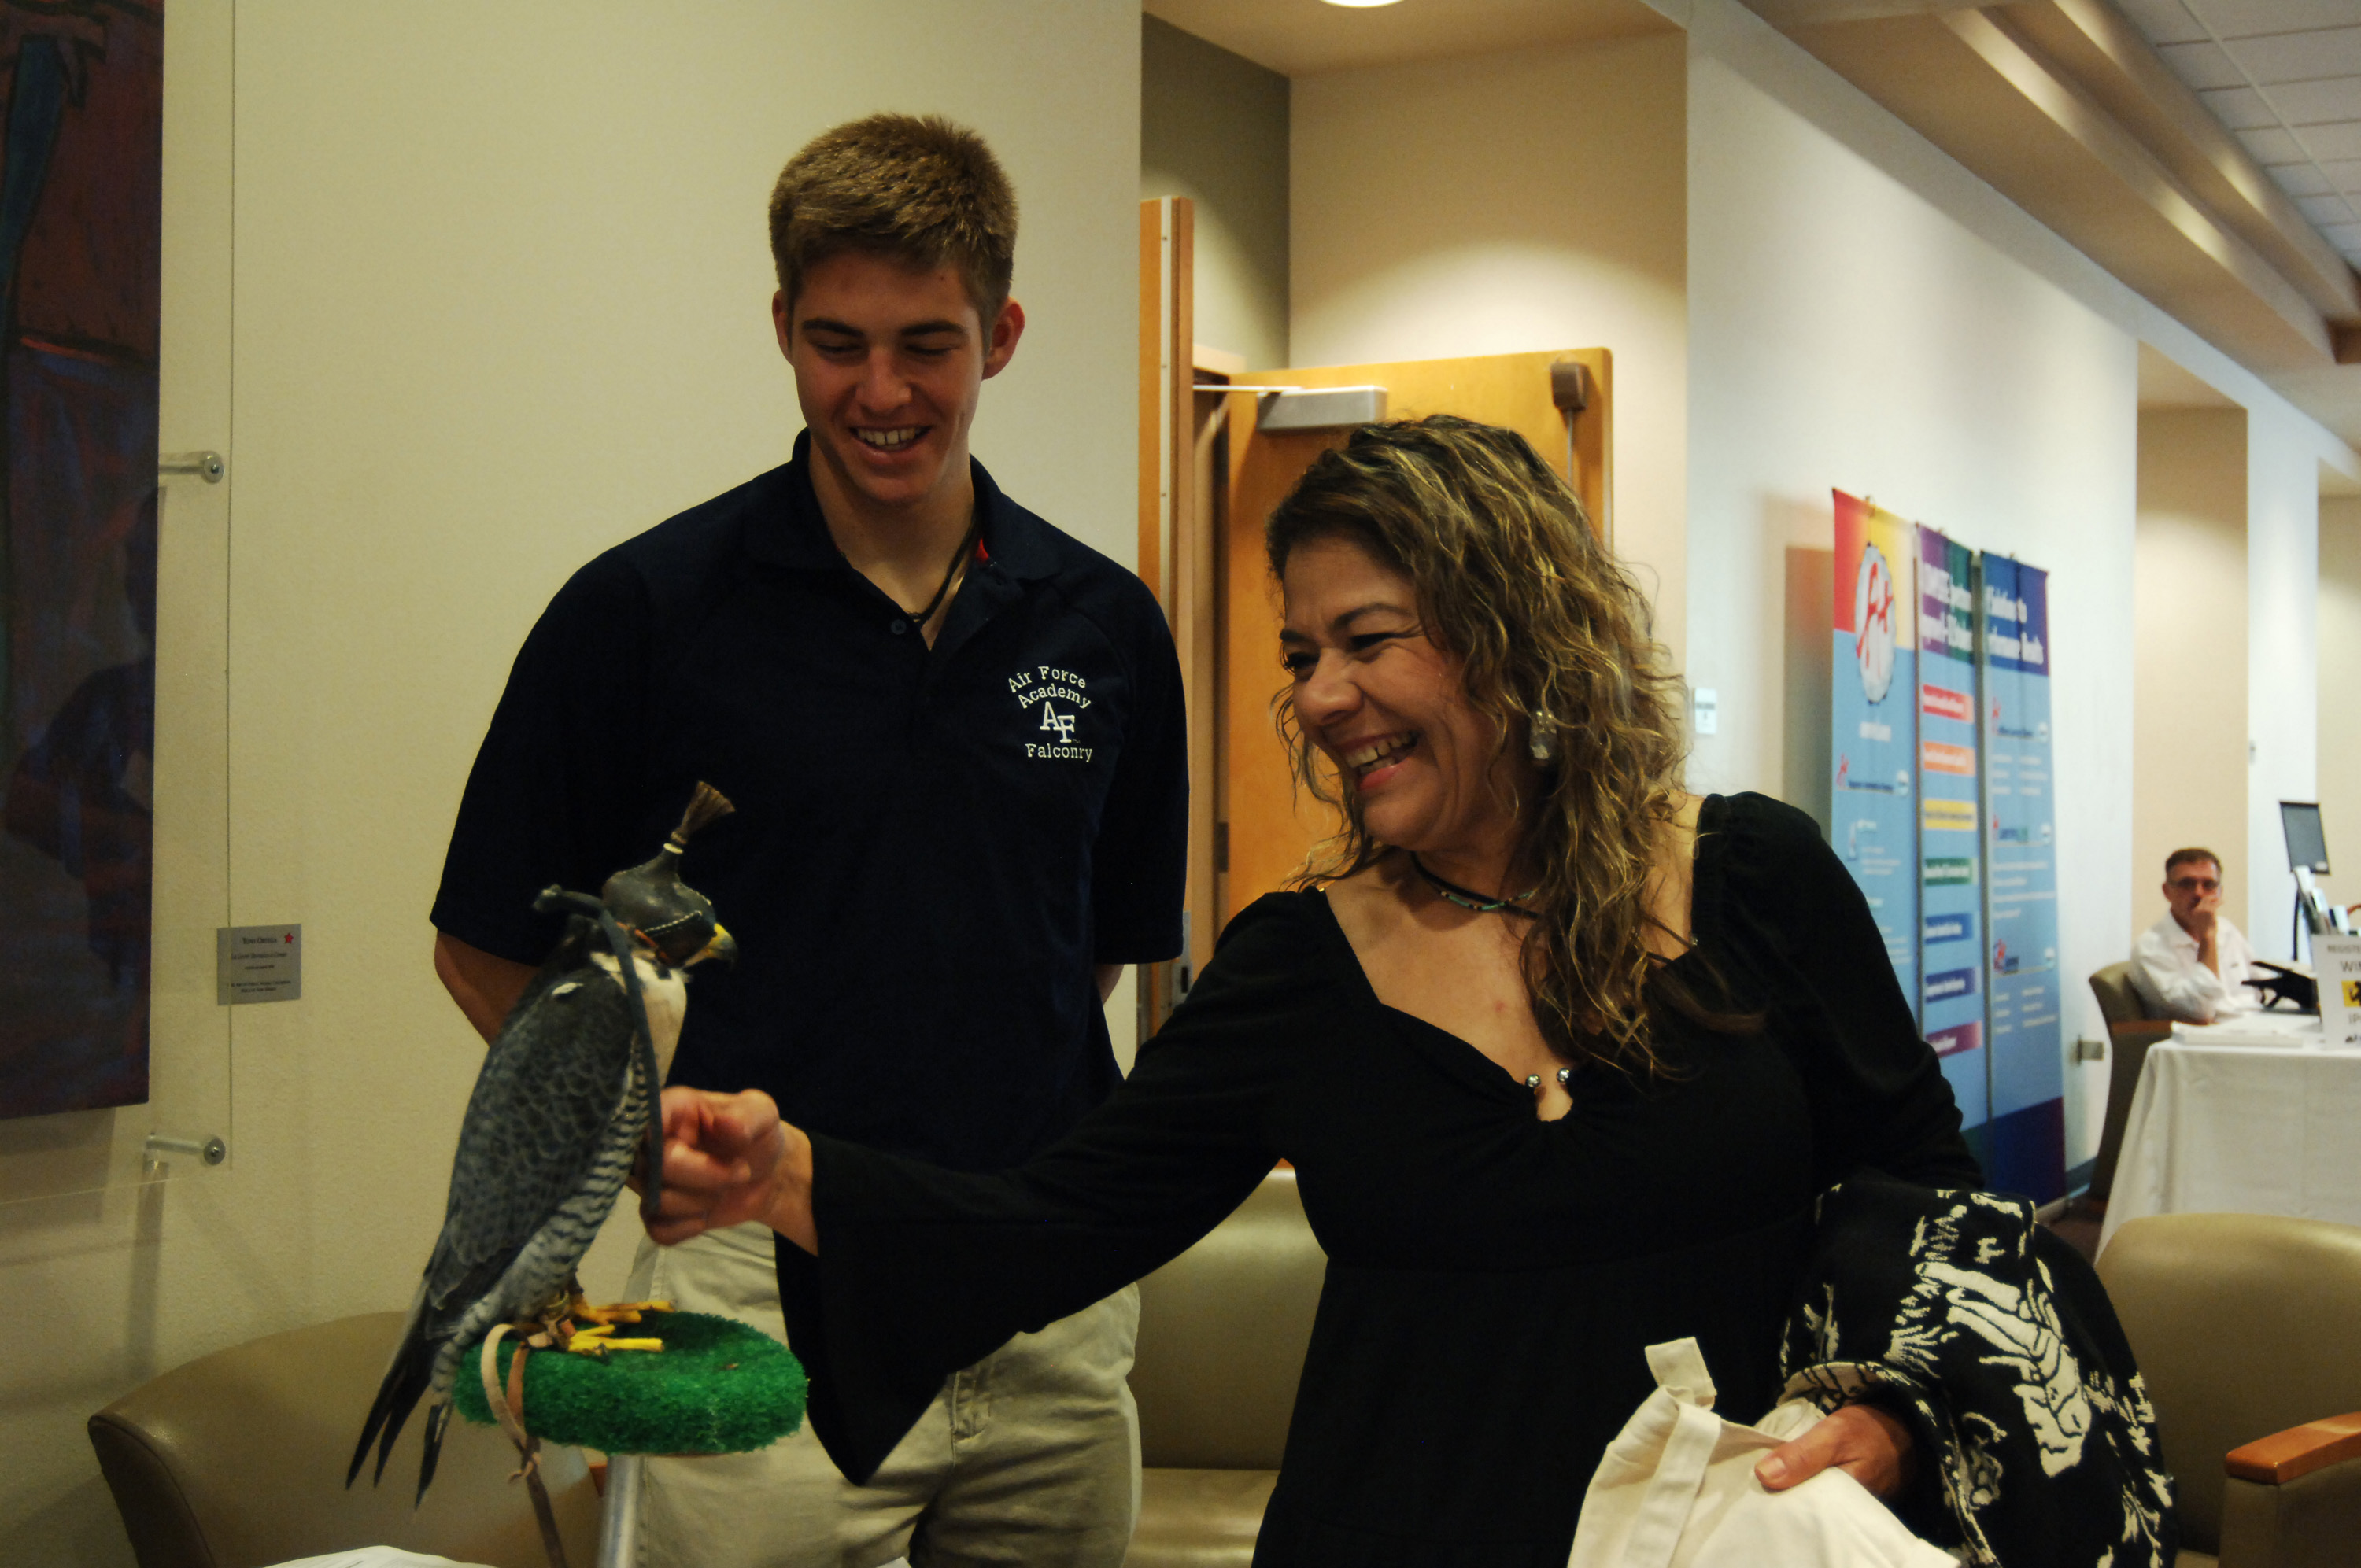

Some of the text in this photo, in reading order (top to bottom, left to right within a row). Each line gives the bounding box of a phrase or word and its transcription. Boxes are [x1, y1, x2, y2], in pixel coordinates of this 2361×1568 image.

[1008, 666, 1086, 693] Air Force
[1018, 683, 1092, 709] Academy
[1039, 700, 1076, 743] AF
[1024, 743, 1093, 762] Falconry
